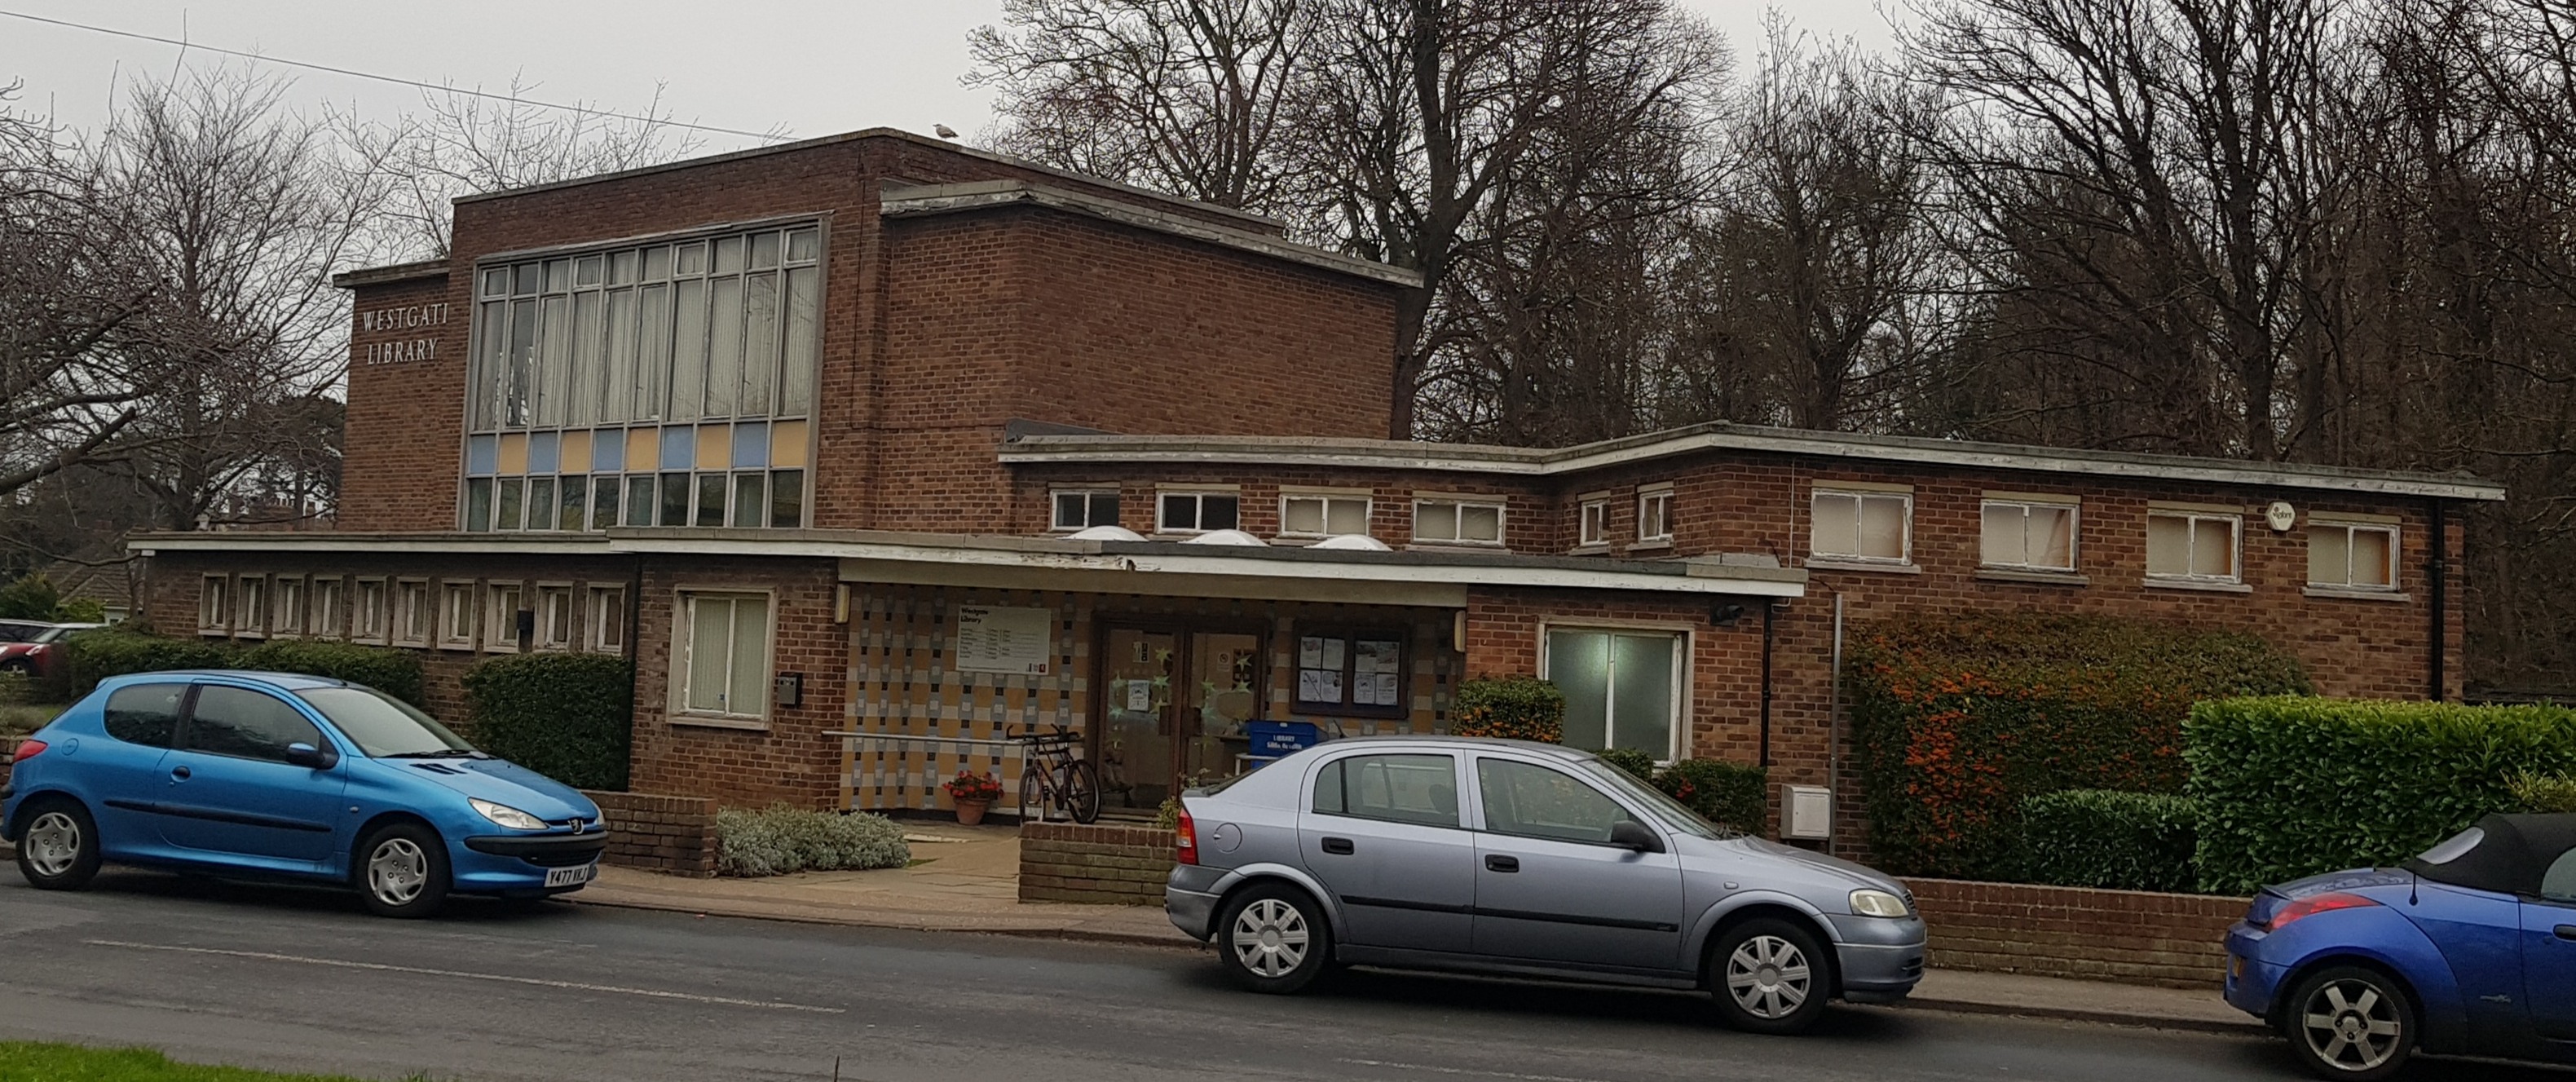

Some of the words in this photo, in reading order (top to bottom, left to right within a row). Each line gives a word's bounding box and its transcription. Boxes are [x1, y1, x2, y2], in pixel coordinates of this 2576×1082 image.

[368, 338, 438, 364] LIBRARY
[960, 616, 981, 624] Library
[549, 870, 572, 885] Y477
